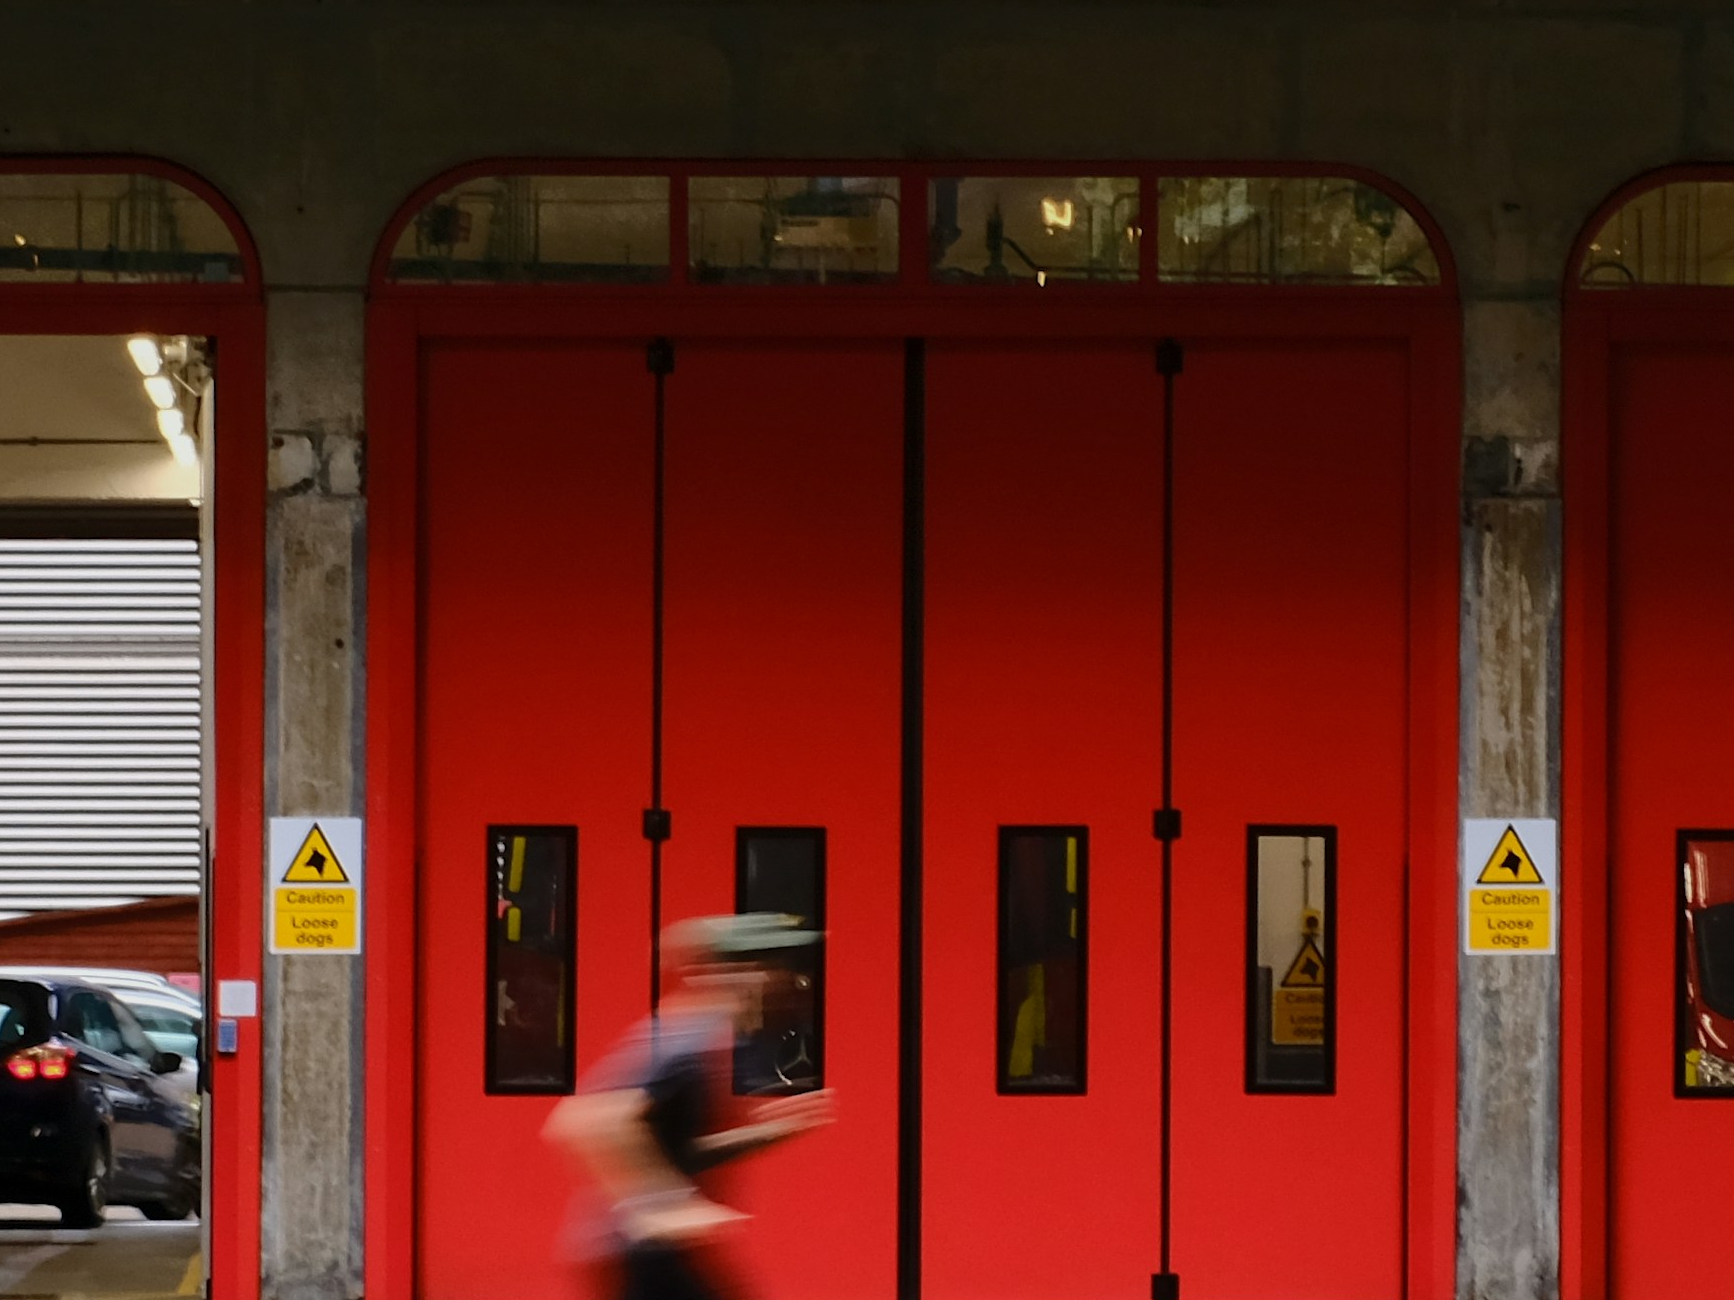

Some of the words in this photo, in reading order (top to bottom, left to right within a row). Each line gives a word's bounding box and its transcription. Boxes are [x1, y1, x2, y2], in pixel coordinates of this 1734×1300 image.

[286, 891, 345, 905] Caution
[1482, 892, 1540, 905] Caution
[291, 916, 339, 929] Loose
[1487, 917, 1534, 930] Loose
[295, 931, 334, 947] dogs
[1491, 933, 1529, 948] dogs
[1285, 992, 1324, 1004] Cautio
